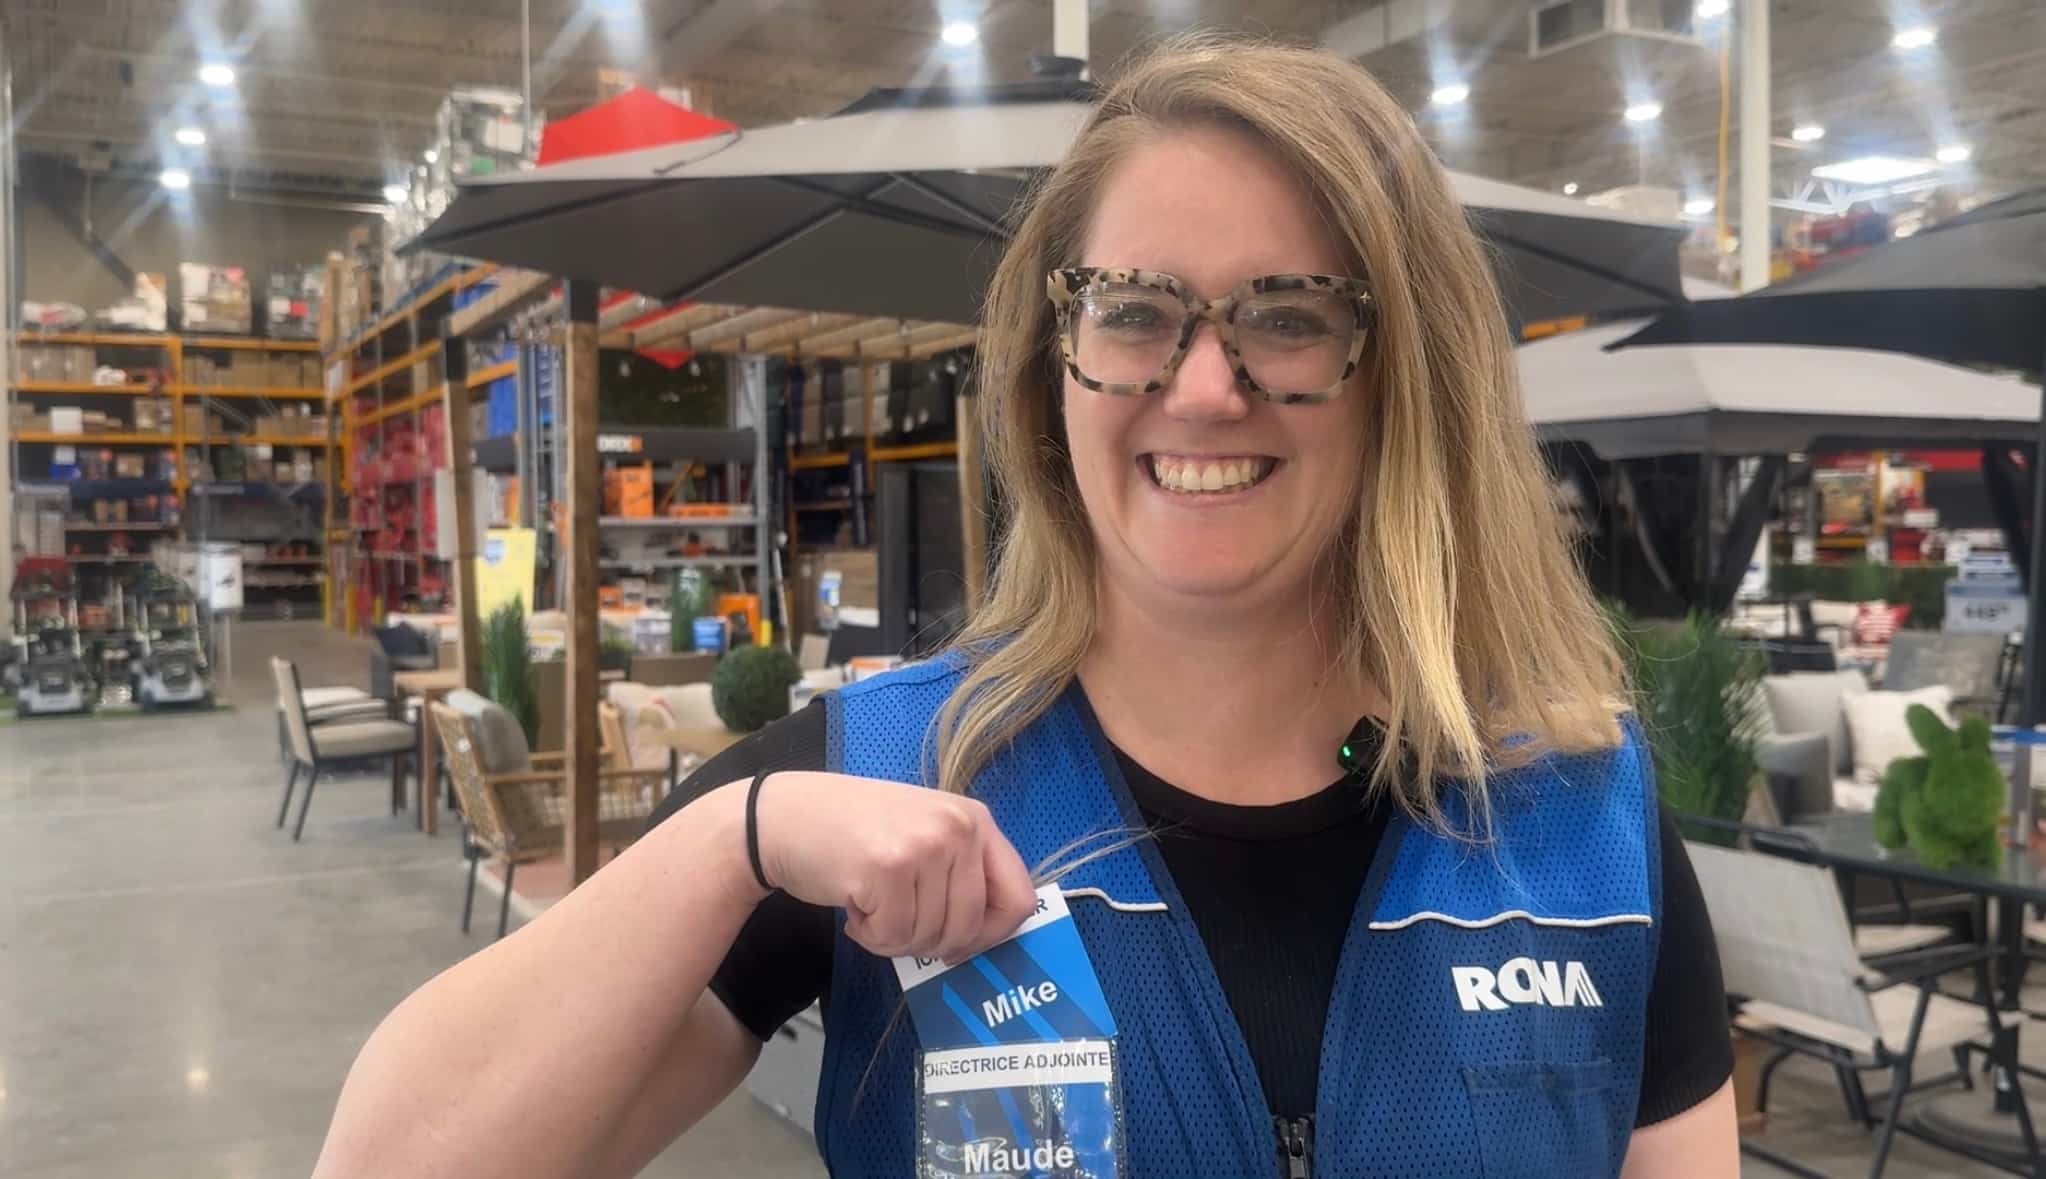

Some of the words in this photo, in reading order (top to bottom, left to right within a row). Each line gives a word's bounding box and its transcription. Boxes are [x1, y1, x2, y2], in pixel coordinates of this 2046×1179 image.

[1451, 956, 1603, 1011] RONA
[981, 981, 1058, 1027] Mike
[924, 1055, 1019, 1078] DIRECTRICE
[1024, 1051, 1109, 1069] ADJOINTE
[963, 1139, 1075, 1174] Maude
